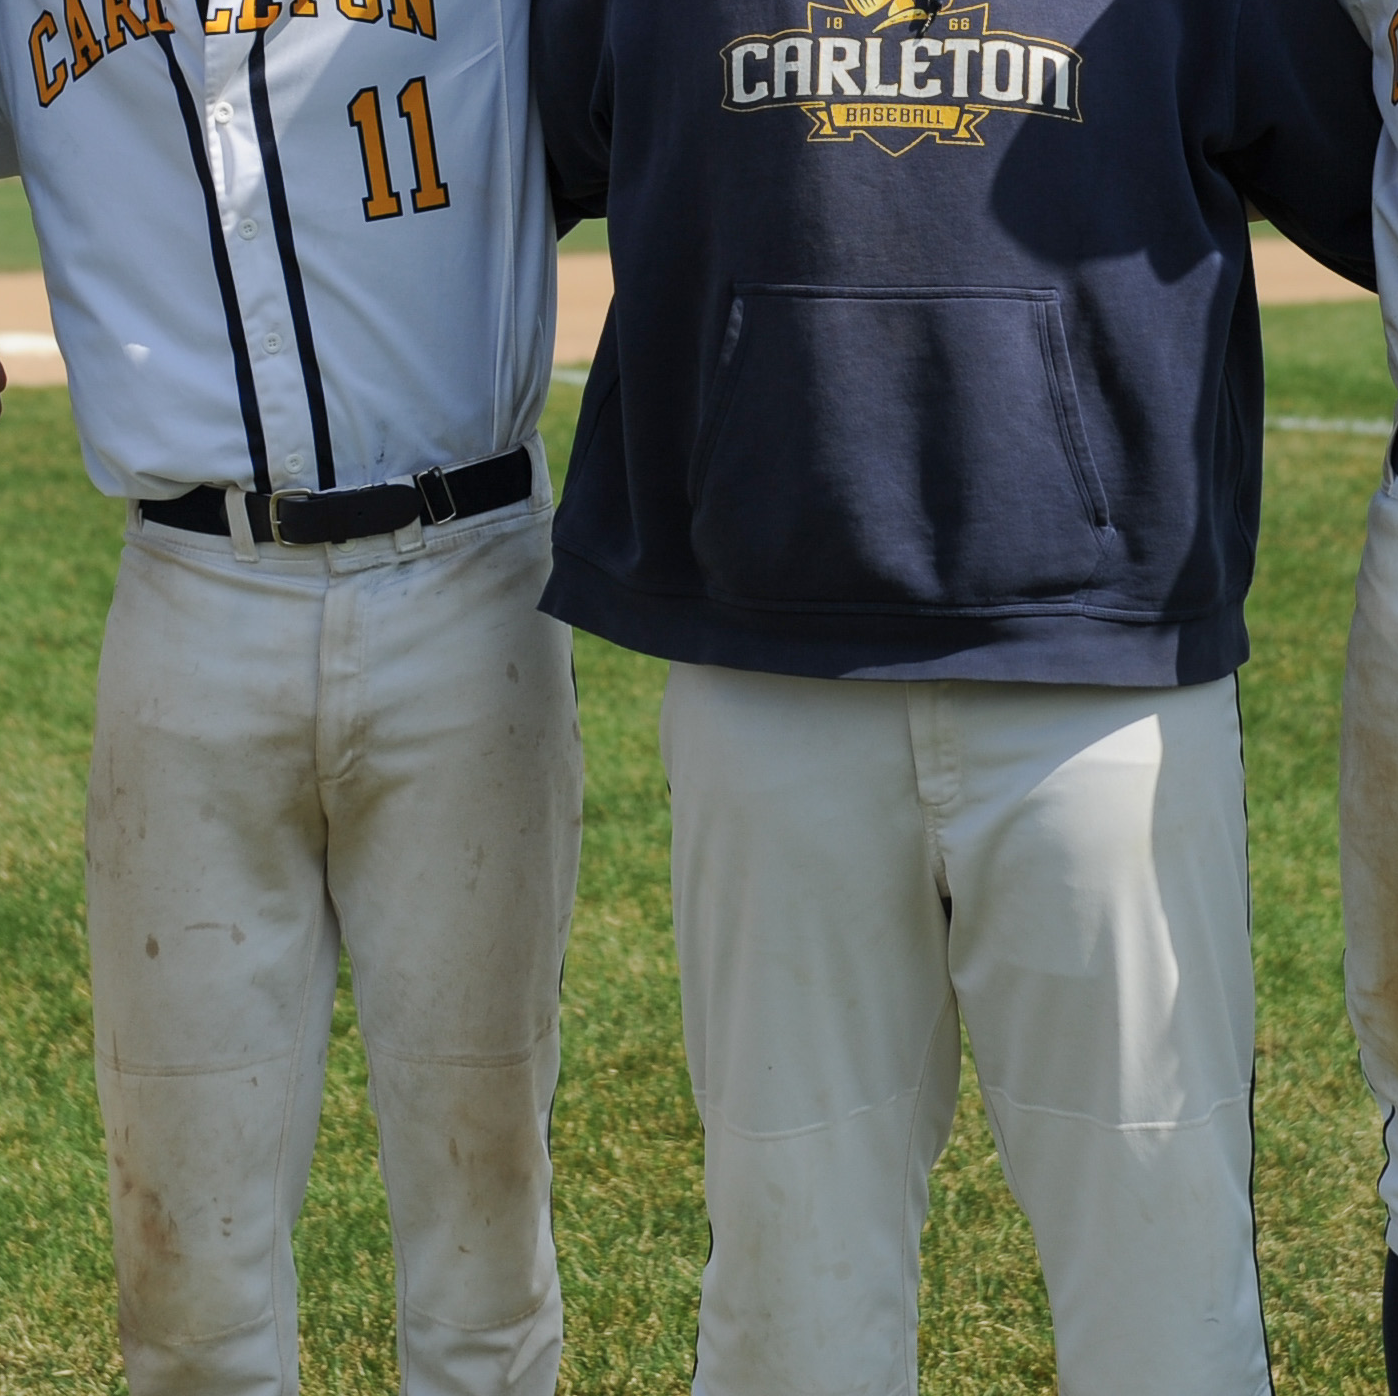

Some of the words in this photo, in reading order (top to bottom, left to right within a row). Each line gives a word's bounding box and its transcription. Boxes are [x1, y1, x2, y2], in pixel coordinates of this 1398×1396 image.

[825, 16, 843, 29] 18
[948, 16, 971, 31] 66
[730, 37, 1071, 111] CARLETON
[845, 106, 944, 125] BASEBALL
[348, 76, 450, 223] 11
